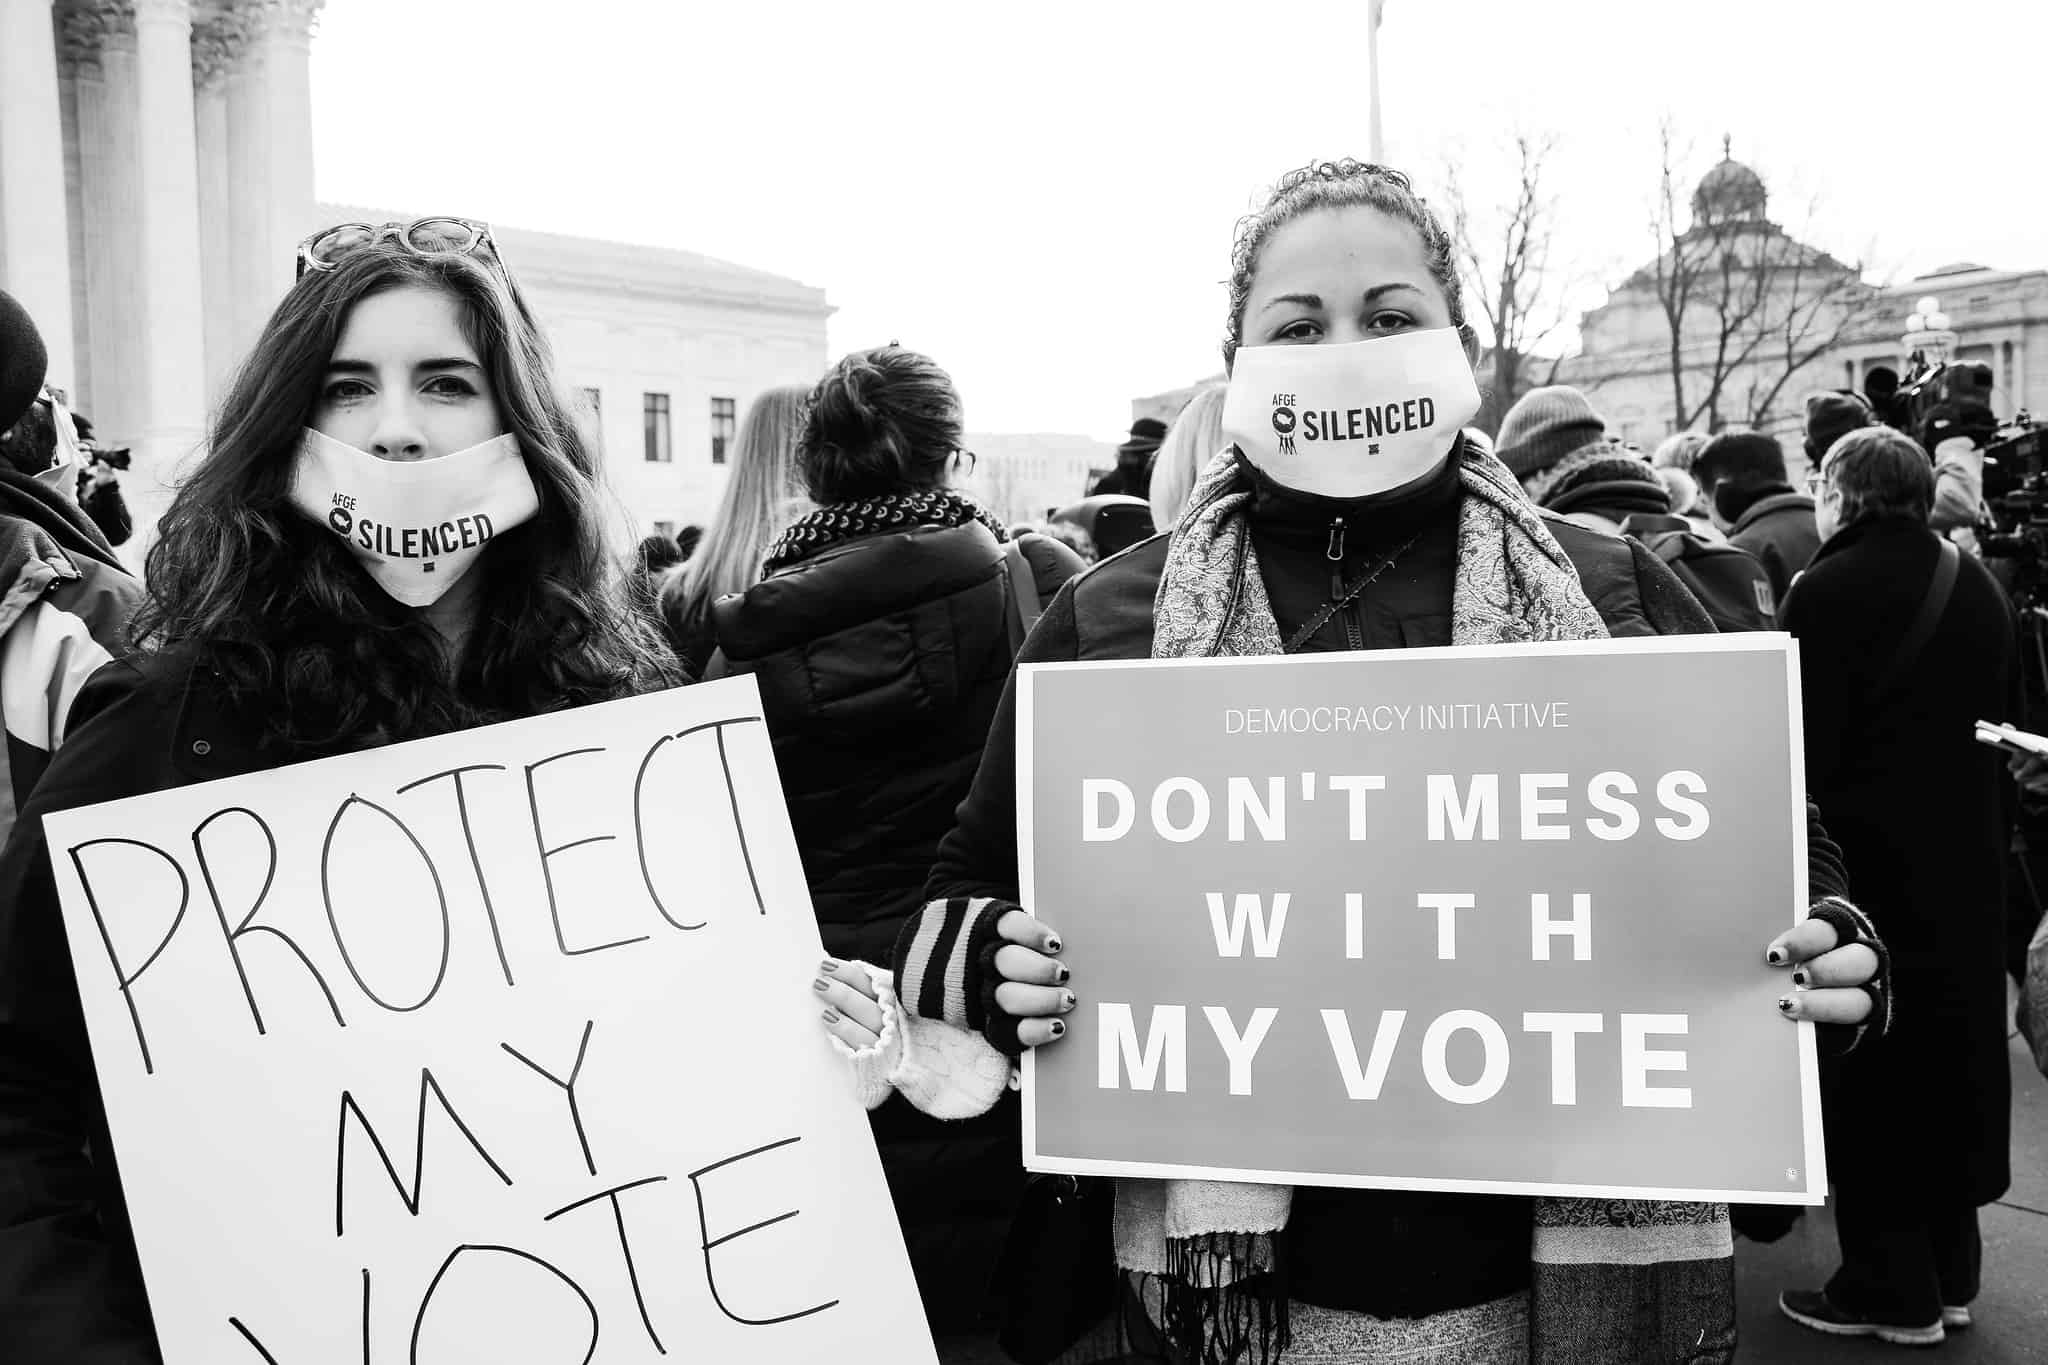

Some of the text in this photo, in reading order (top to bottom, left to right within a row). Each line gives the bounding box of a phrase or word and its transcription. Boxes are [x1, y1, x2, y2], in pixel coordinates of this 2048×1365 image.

[1272, 393, 1297, 407] AFGE
[1303, 398, 1435, 441] SILENCED
[332, 492, 356, 510] AFGE
[358, 513, 494, 558] SILENCED
[1225, 702, 1569, 734] DEMOCRACY INITIATIVE
[1082, 770, 1710, 842] DON'T MESS
[68, 716, 767, 1074] PROTECT
[1206, 892, 1592, 961] WITH
[1098, 1003, 1693, 1108] MY VOTE
[337, 1021, 597, 1237] MY
